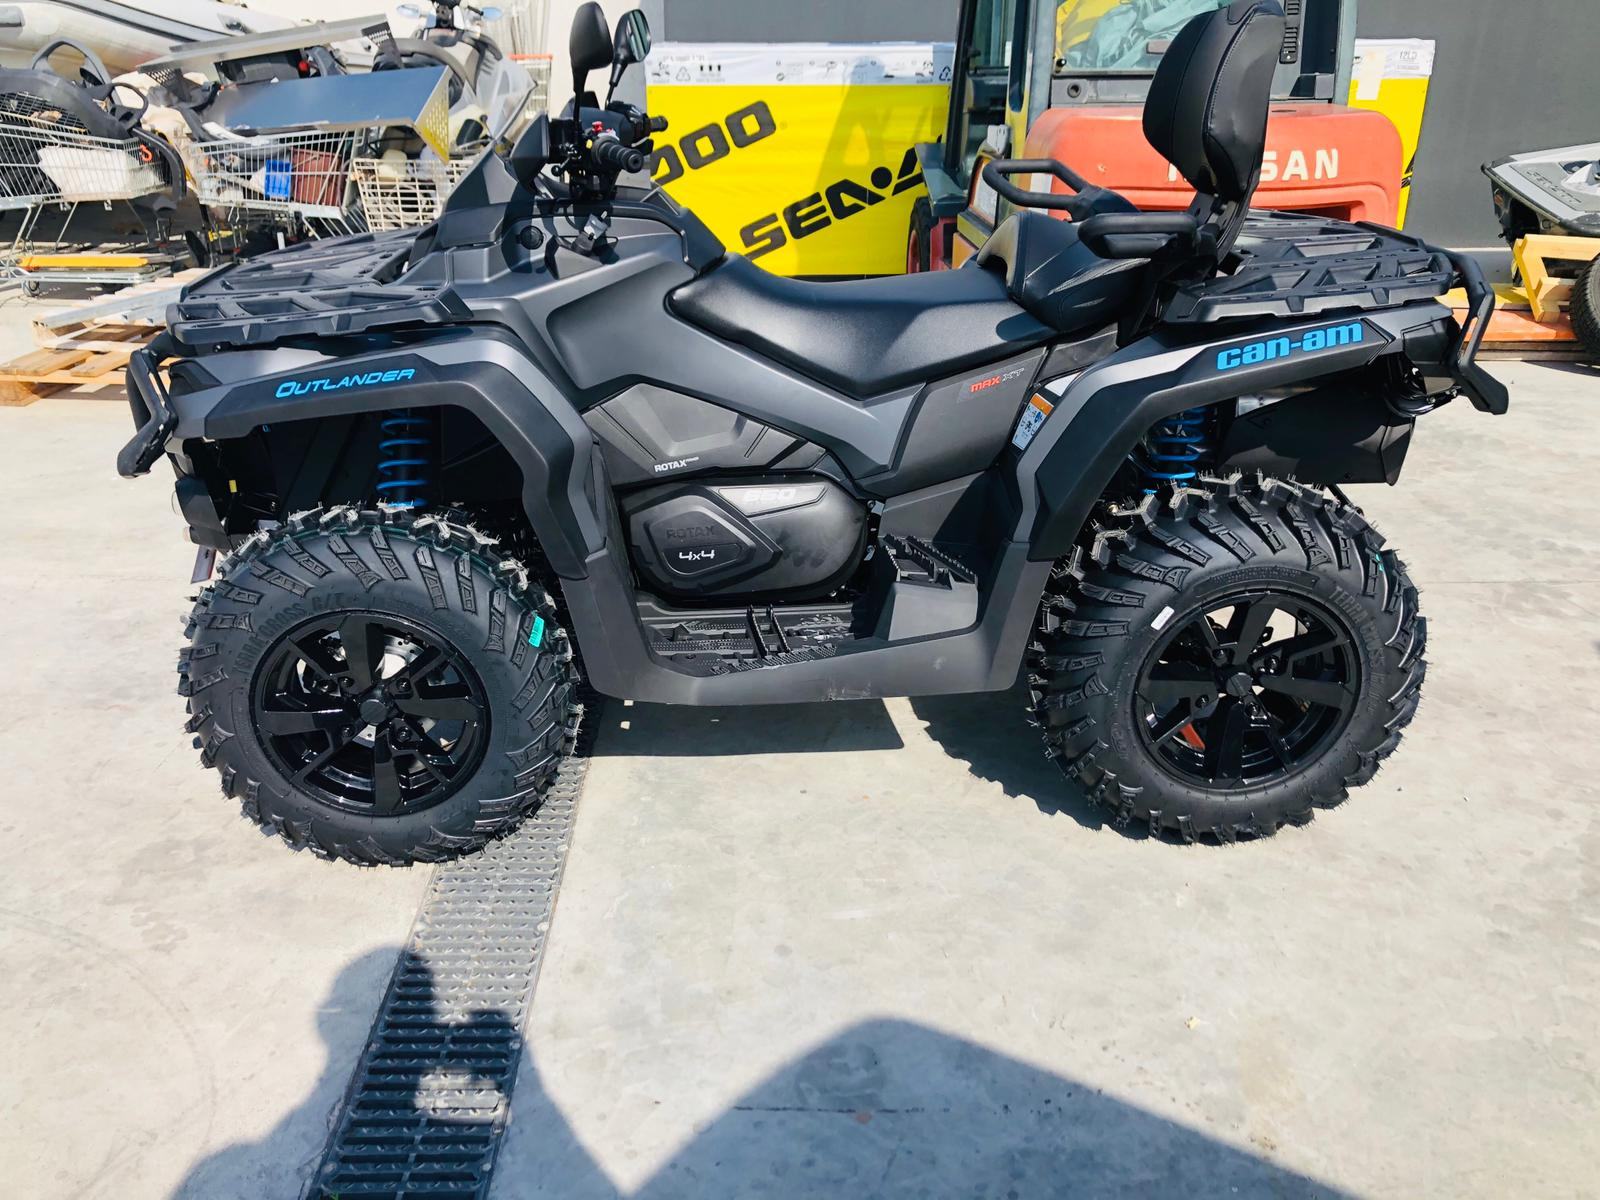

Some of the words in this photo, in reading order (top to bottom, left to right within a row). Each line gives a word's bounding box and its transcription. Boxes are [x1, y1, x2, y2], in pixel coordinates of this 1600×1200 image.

[1215, 321, 1363, 370] can-am
[275, 368, 416, 399] OUTLANDER
[970, 375, 1001, 393] MAX
[1001, 367, 1025, 382] XT
[653, 459, 688, 473] ROTAX
[666, 525, 715, 539] ROTAX
[678, 549, 715, 561] 4x4
[1328, 584, 1369, 624] TERRA
[256, 600, 305, 639] CROSS
